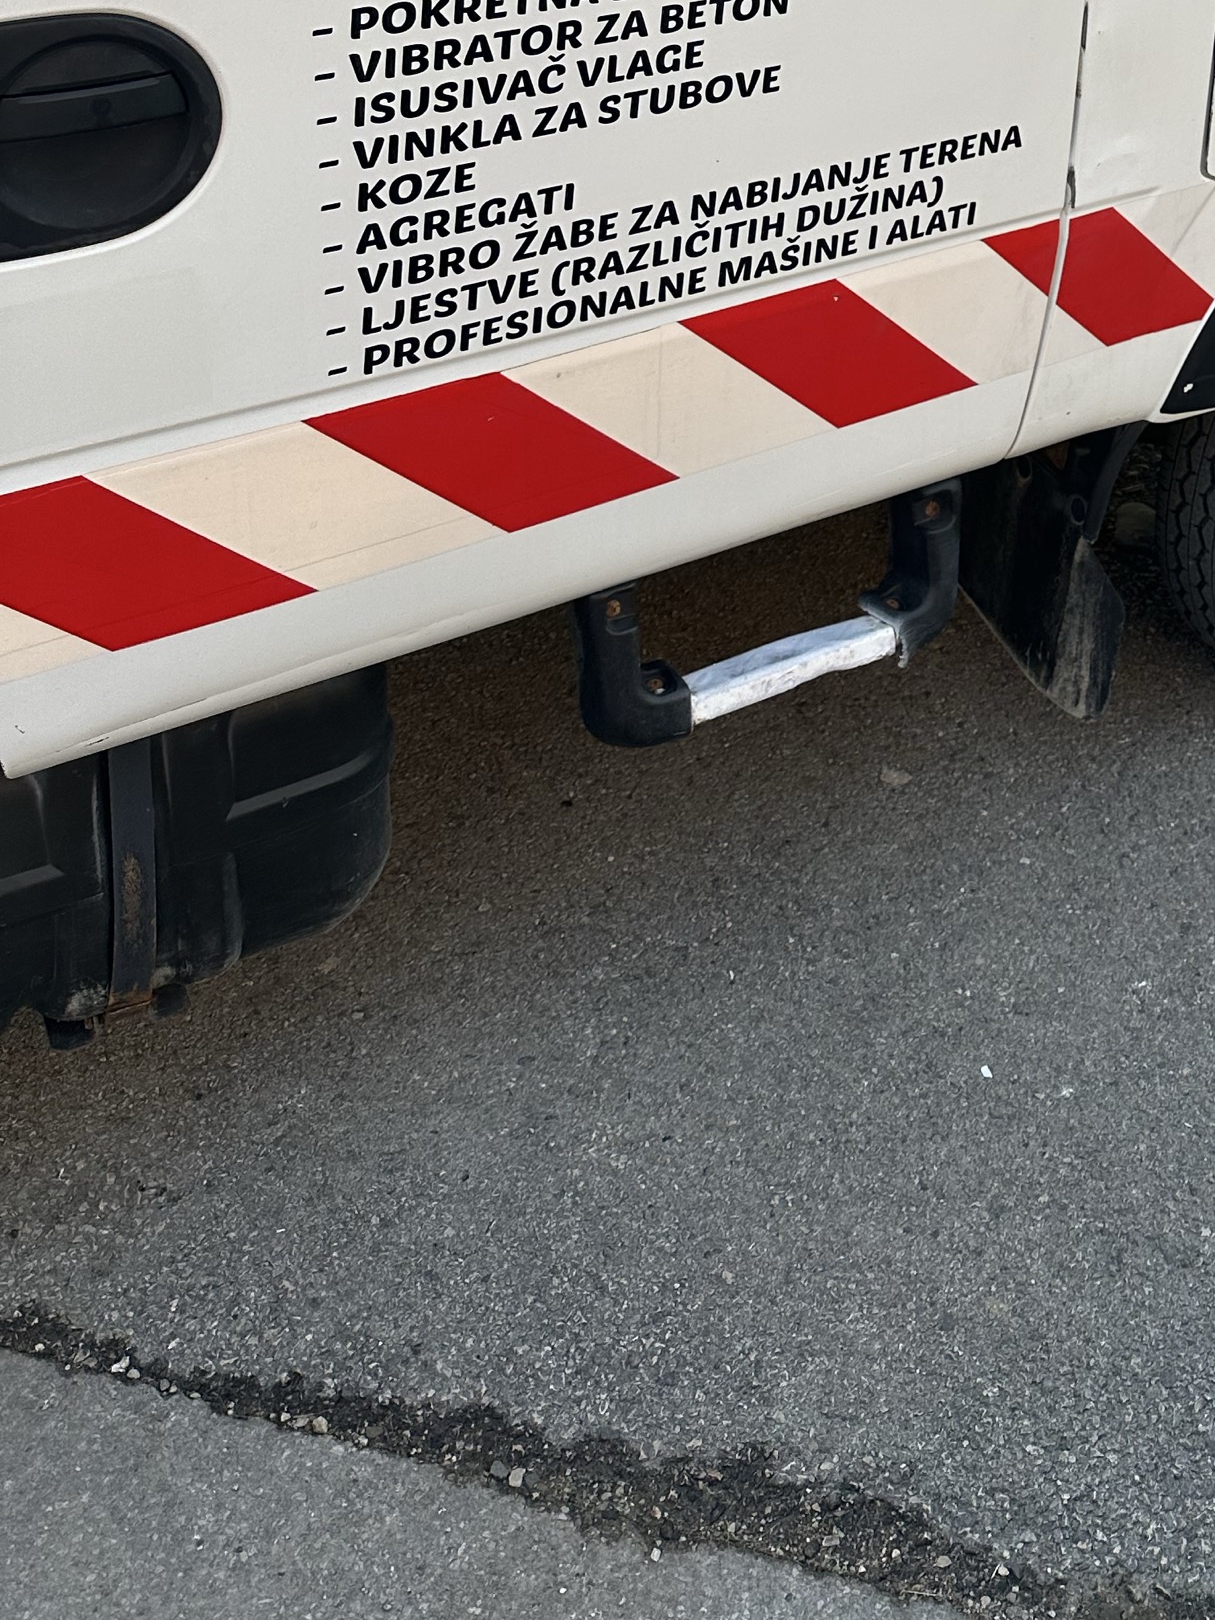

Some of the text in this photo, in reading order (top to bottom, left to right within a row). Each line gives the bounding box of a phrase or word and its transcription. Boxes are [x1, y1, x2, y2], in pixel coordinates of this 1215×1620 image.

[348, 19, 583, 83] VIBRATOR
[594, 9, 649, 46] ZA
[354, 53, 566, 128] ISUSIVAČ
[576, 39, 705, 88] VLAGE
[352, 113, 523, 170] VINKLA
[531, 101, 588, 138] ZA
[598, 64, 782, 125] STUBOVE
[355, 182, 575, 255] AGREGATI
[357, 161, 476, 213] KOZE
[357, 239, 501, 294] VIBRO
[512, 211, 619, 262] ŽABE
[628, 200, 680, 236] ZA
[690, 152, 891, 221] NABIJANJE
[899, 125, 1022, 174] TERENA
[361, 268, 540, 336] LJESTVE
[551, 211, 785, 297] (RAZLIČITIH
[796, 175, 944, 233] DUŽINA)
[363, 266, 707, 376] PROFESIONALNE
[717, 229, 859, 288] MAŠINE
[868, 225, 878, 250] I
[885, 201, 977, 246] ALATI
